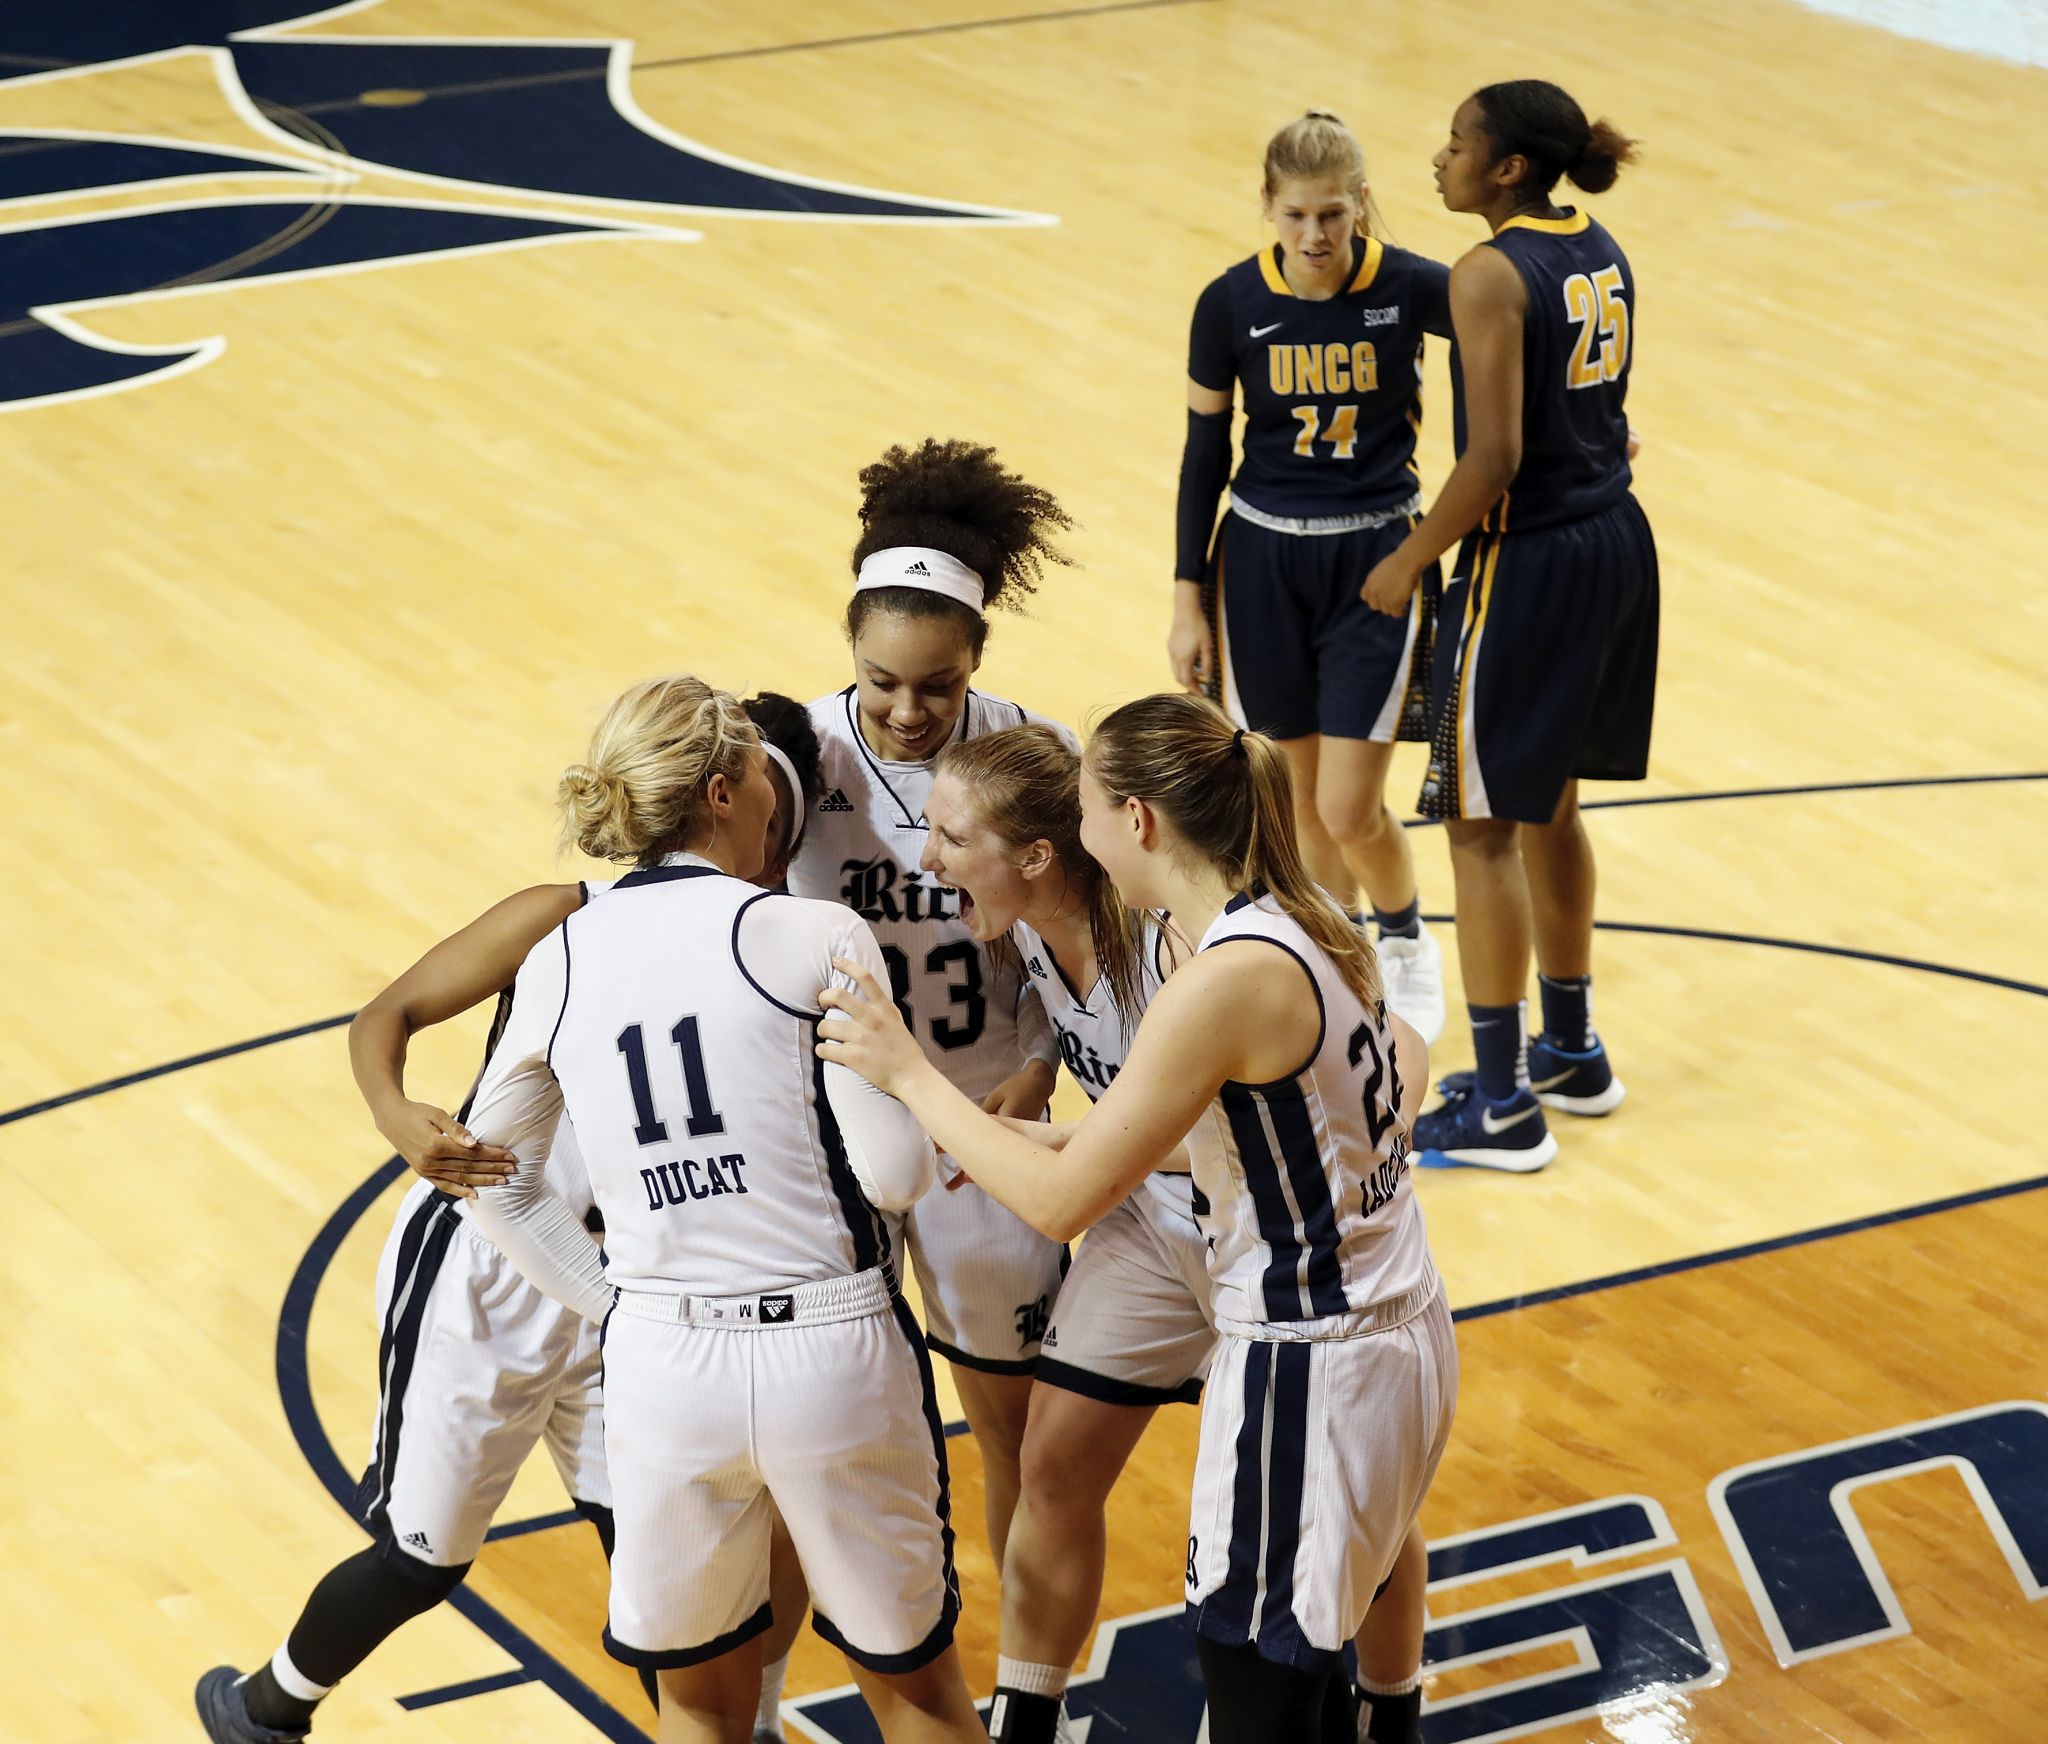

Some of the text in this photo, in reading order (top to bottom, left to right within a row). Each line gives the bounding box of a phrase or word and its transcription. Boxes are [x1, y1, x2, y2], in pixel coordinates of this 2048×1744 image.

[1563, 262, 1630, 390] 25
[1268, 341, 1378, 395] UNCG
[1291, 405, 1358, 460] 14
[904, 568, 931, 577] adidas
[819, 803, 854, 812] adidas
[840, 852, 961, 923] Ric
[1053, 1016, 1121, 1089] Ri
[615, 1012, 728, 1149] 11
[640, 1153, 749, 1211] DUCAT
[739, 1304, 752, 1318] M
[762, 1299, 789, 1307] adidas
